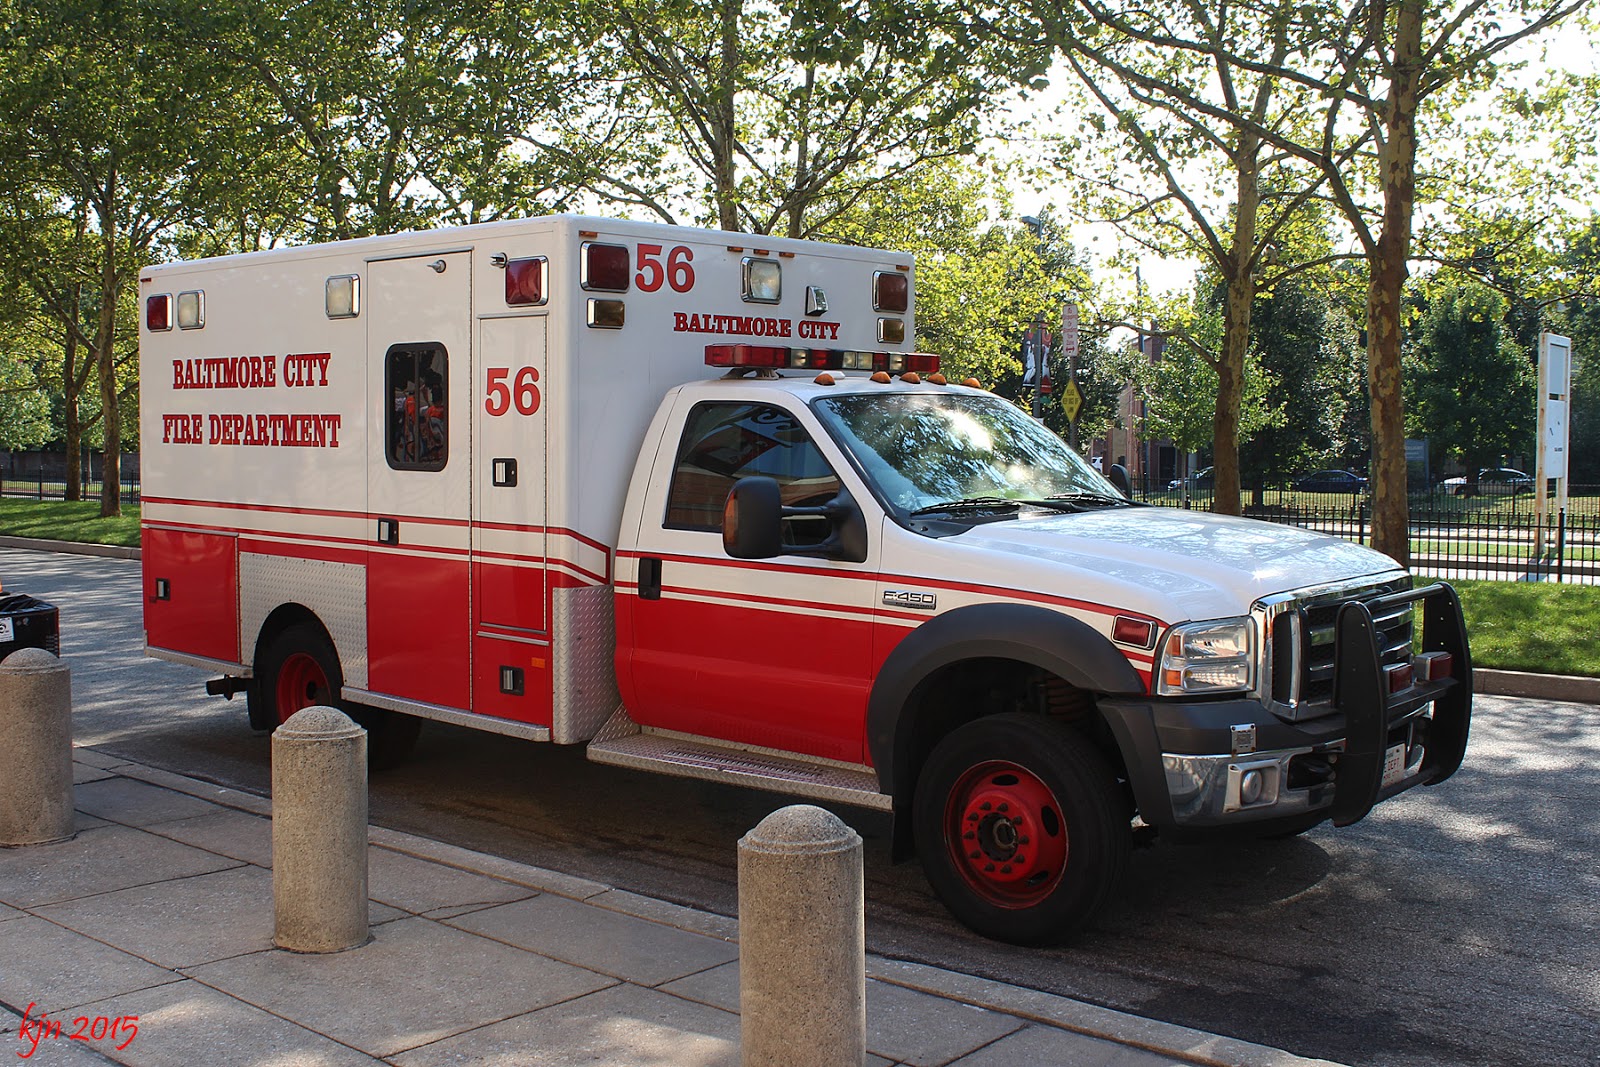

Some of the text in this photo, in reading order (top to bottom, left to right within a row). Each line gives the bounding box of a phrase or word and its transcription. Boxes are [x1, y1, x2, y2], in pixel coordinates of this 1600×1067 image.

[635, 243, 695, 292] 56
[673, 312, 840, 340] BALTIMORE CITY
[172, 353, 331, 389] BALTIMORE CITY
[485, 366, 541, 416] 56
[162, 414, 341, 447] FIRE DEPARTMENT
